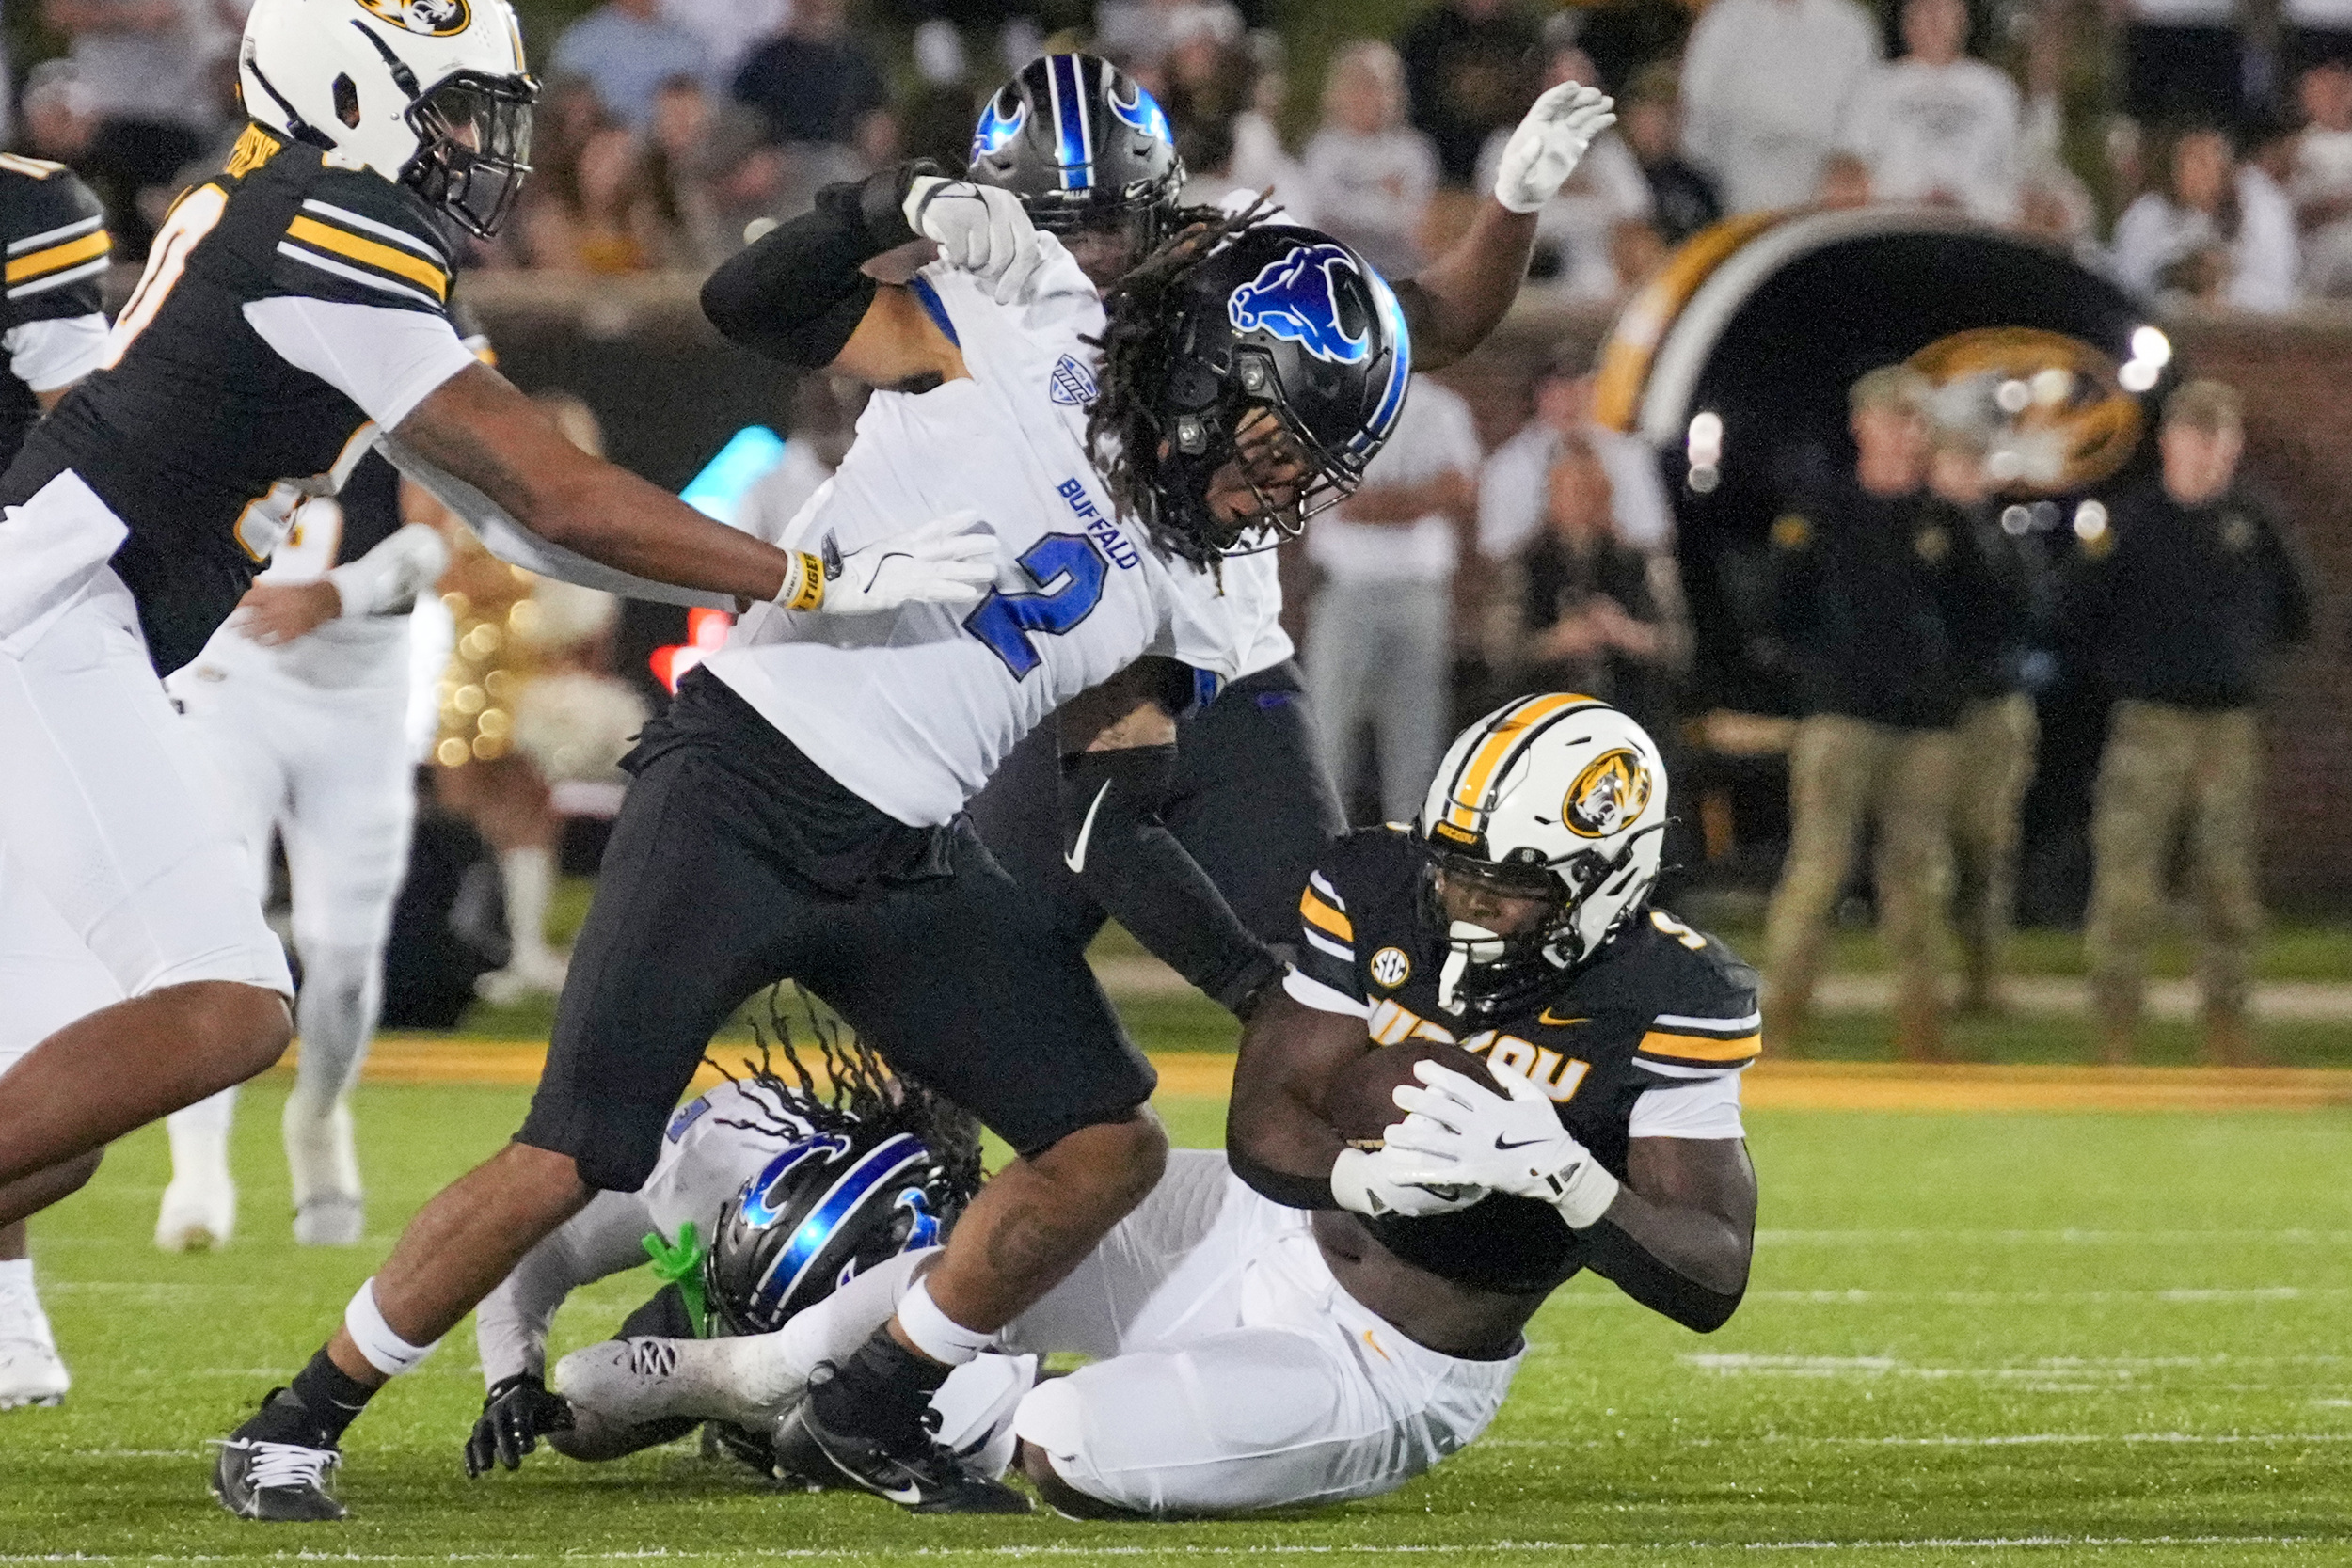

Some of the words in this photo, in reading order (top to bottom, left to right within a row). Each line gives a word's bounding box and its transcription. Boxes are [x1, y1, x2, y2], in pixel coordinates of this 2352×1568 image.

[1056, 477, 1140, 570] BUFFALO
[961, 531, 1109, 683] 2
[1374, 949, 1406, 984] SEC
